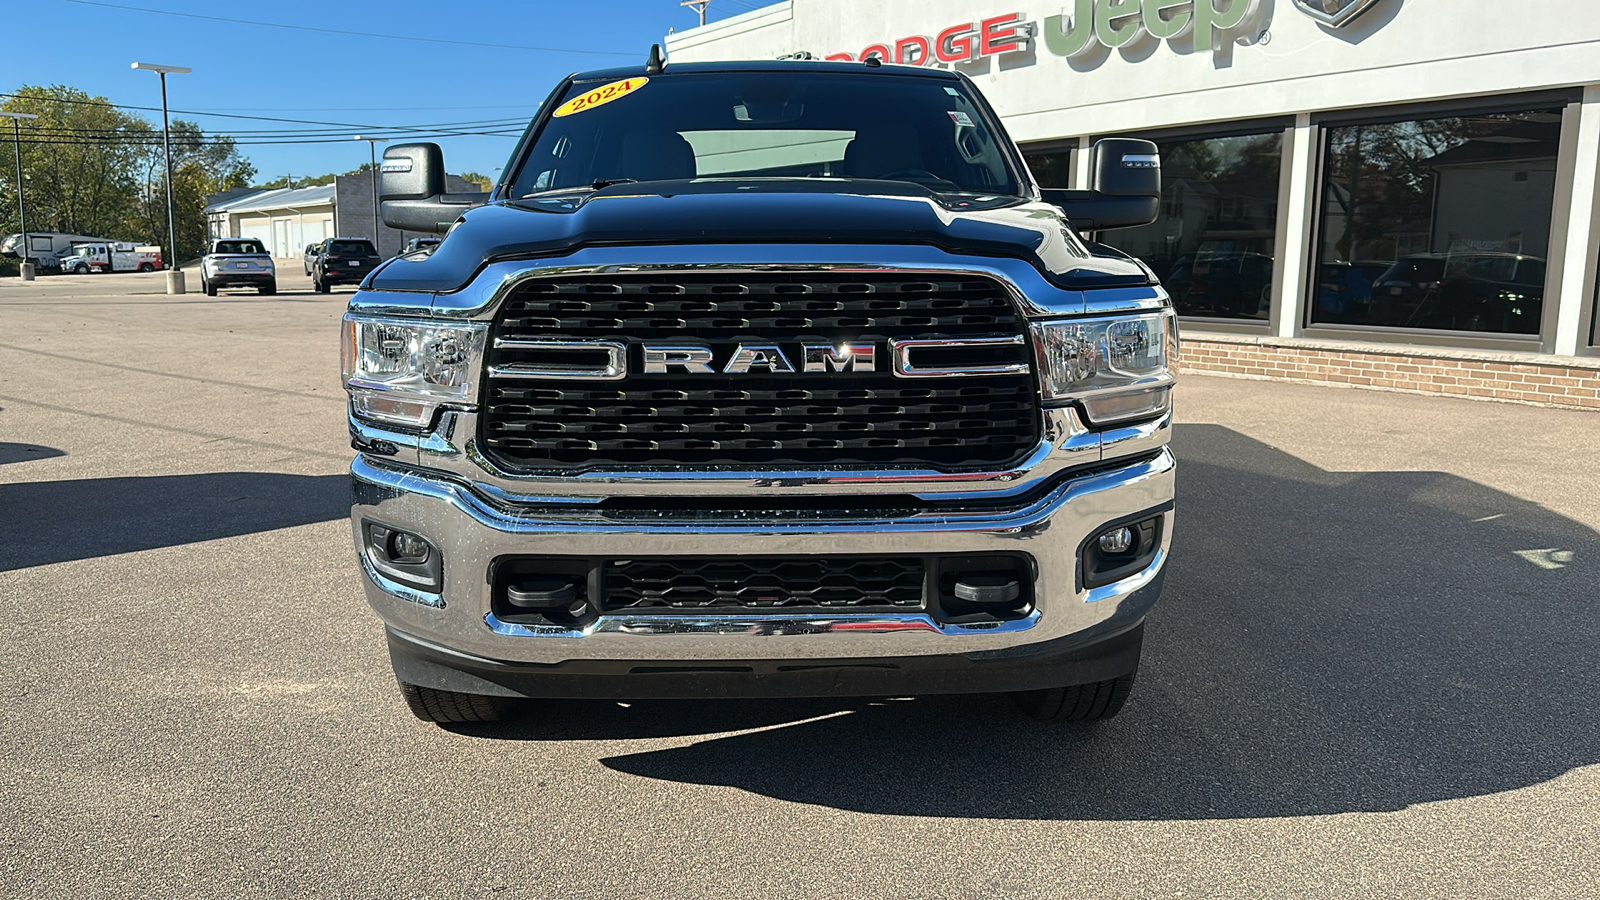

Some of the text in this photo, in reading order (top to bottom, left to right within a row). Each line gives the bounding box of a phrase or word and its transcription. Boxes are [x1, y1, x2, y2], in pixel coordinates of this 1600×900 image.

[1044, 0, 1253, 57] Jeep
[572, 80, 634, 112] 2024
[642, 342, 876, 374] RAM
